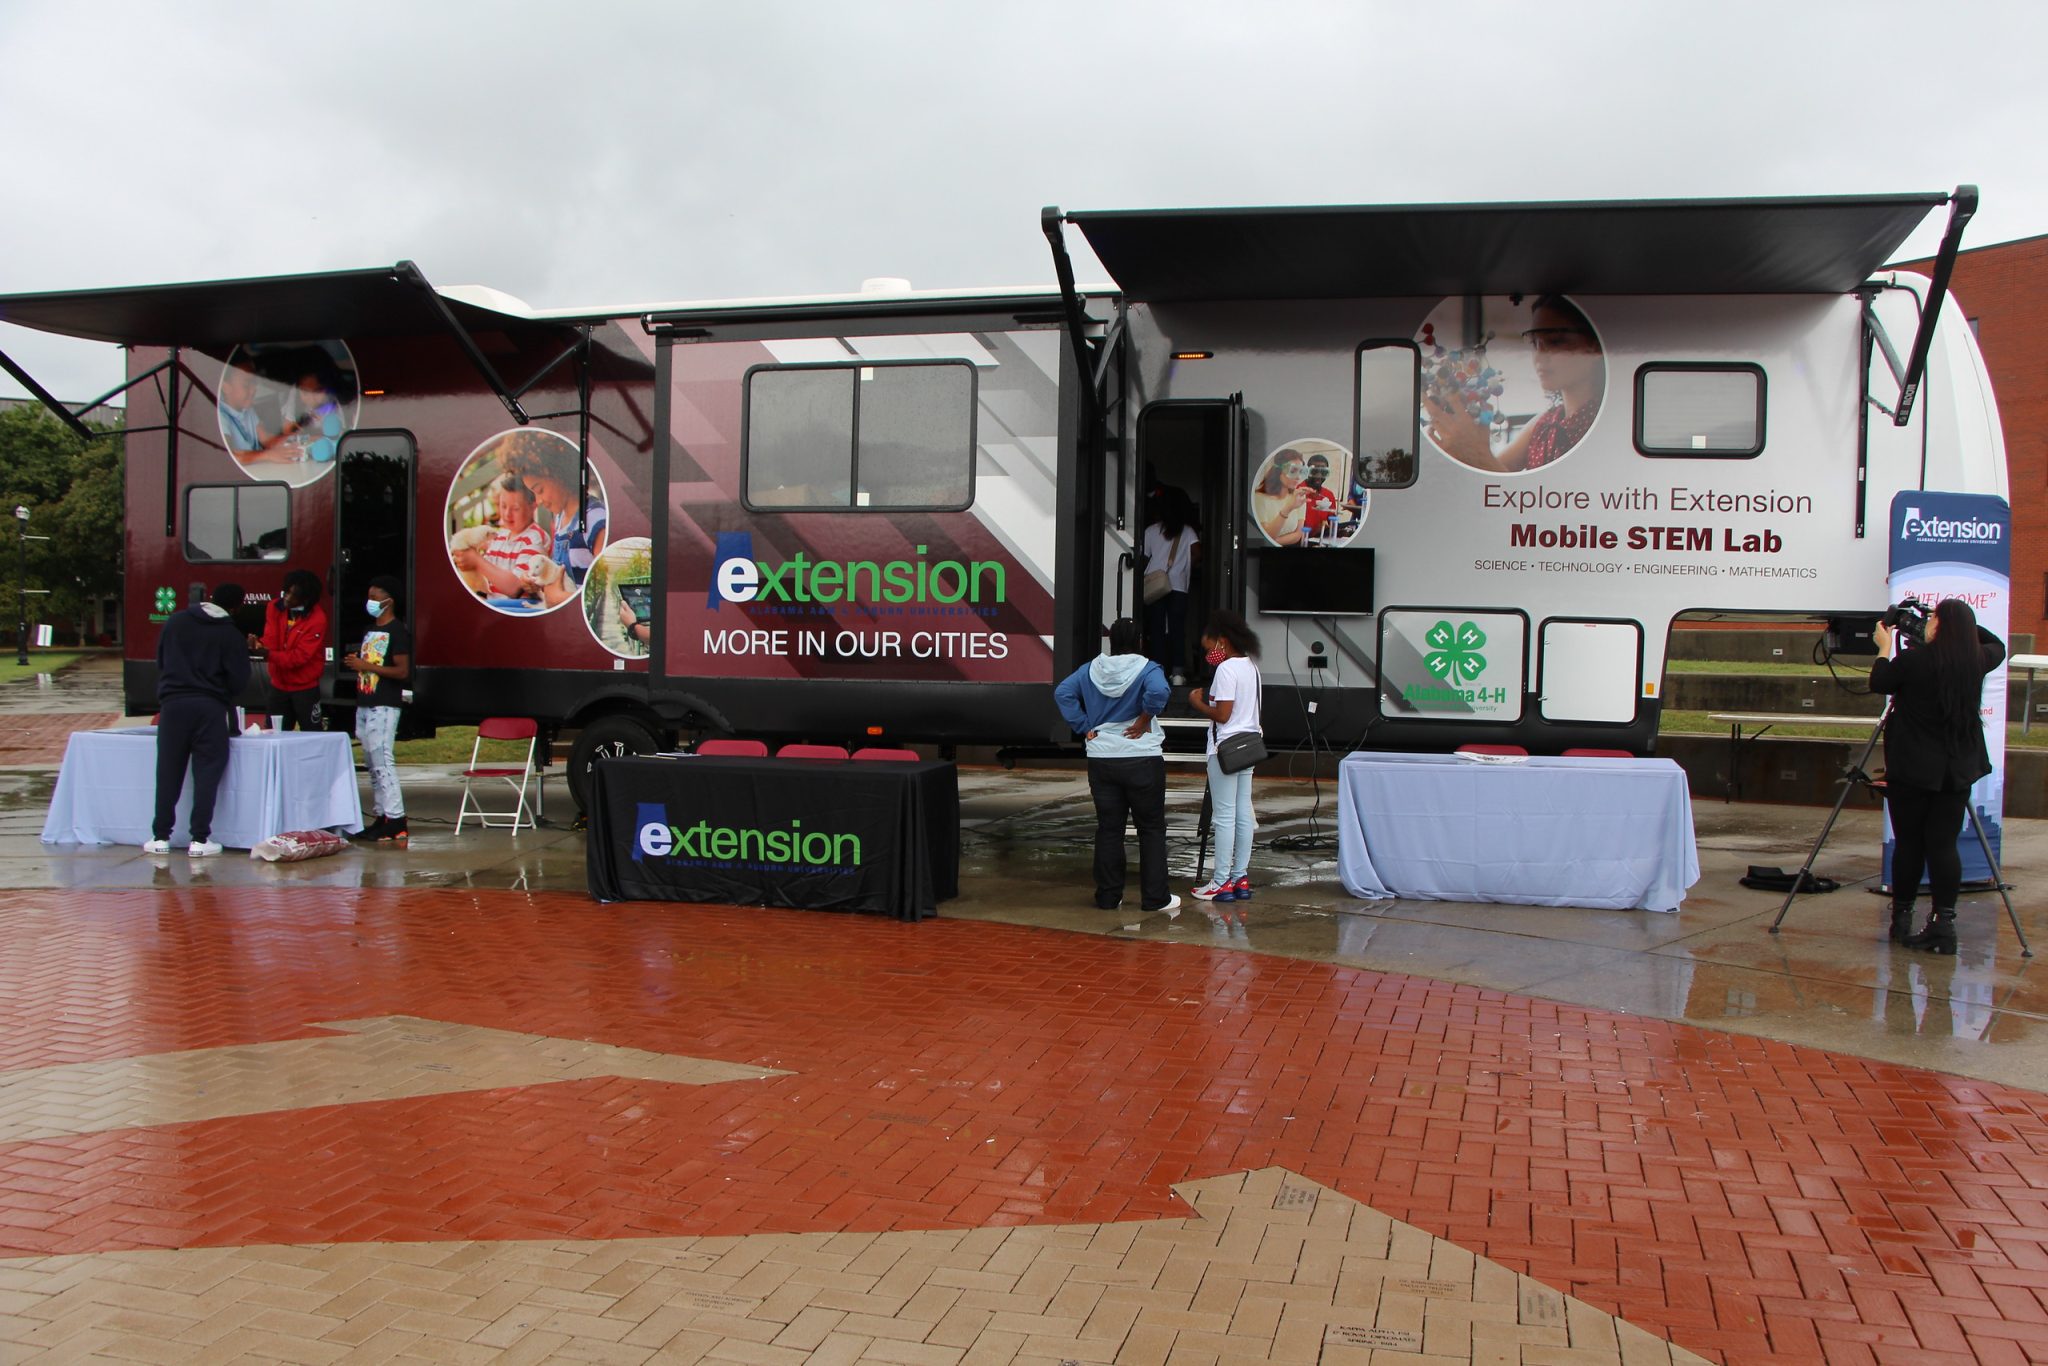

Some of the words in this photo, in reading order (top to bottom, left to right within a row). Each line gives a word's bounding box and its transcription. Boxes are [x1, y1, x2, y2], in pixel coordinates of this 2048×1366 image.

[1484, 484, 1590, 514] Explore
[1600, 486, 1658, 510] with
[1670, 487, 1812, 513] Extension
[1511, 523, 1618, 549] Mobile
[1627, 526, 1713, 550] STEM
[1724, 528, 1783, 553] Lab
[1905, 516, 2001, 539] extension
[717, 544, 1006, 604] extension
[1474, 559, 1527, 571] SCIENCE
[1538, 561, 1623, 573] TECHNOLOGY
[1634, 563, 1718, 576] ENGINEERING
[1729, 566, 1817, 578] MATHEMATICS
[243, 593, 272, 601] ABAMA
[703, 630, 788, 656] MORE
[798, 631, 825, 656] IN
[835, 631, 902, 657] OUR
[911, 632, 1009, 659] CITIES
[1477, 687, 1506, 703] 4-H
[640, 820, 862, 865] extension
